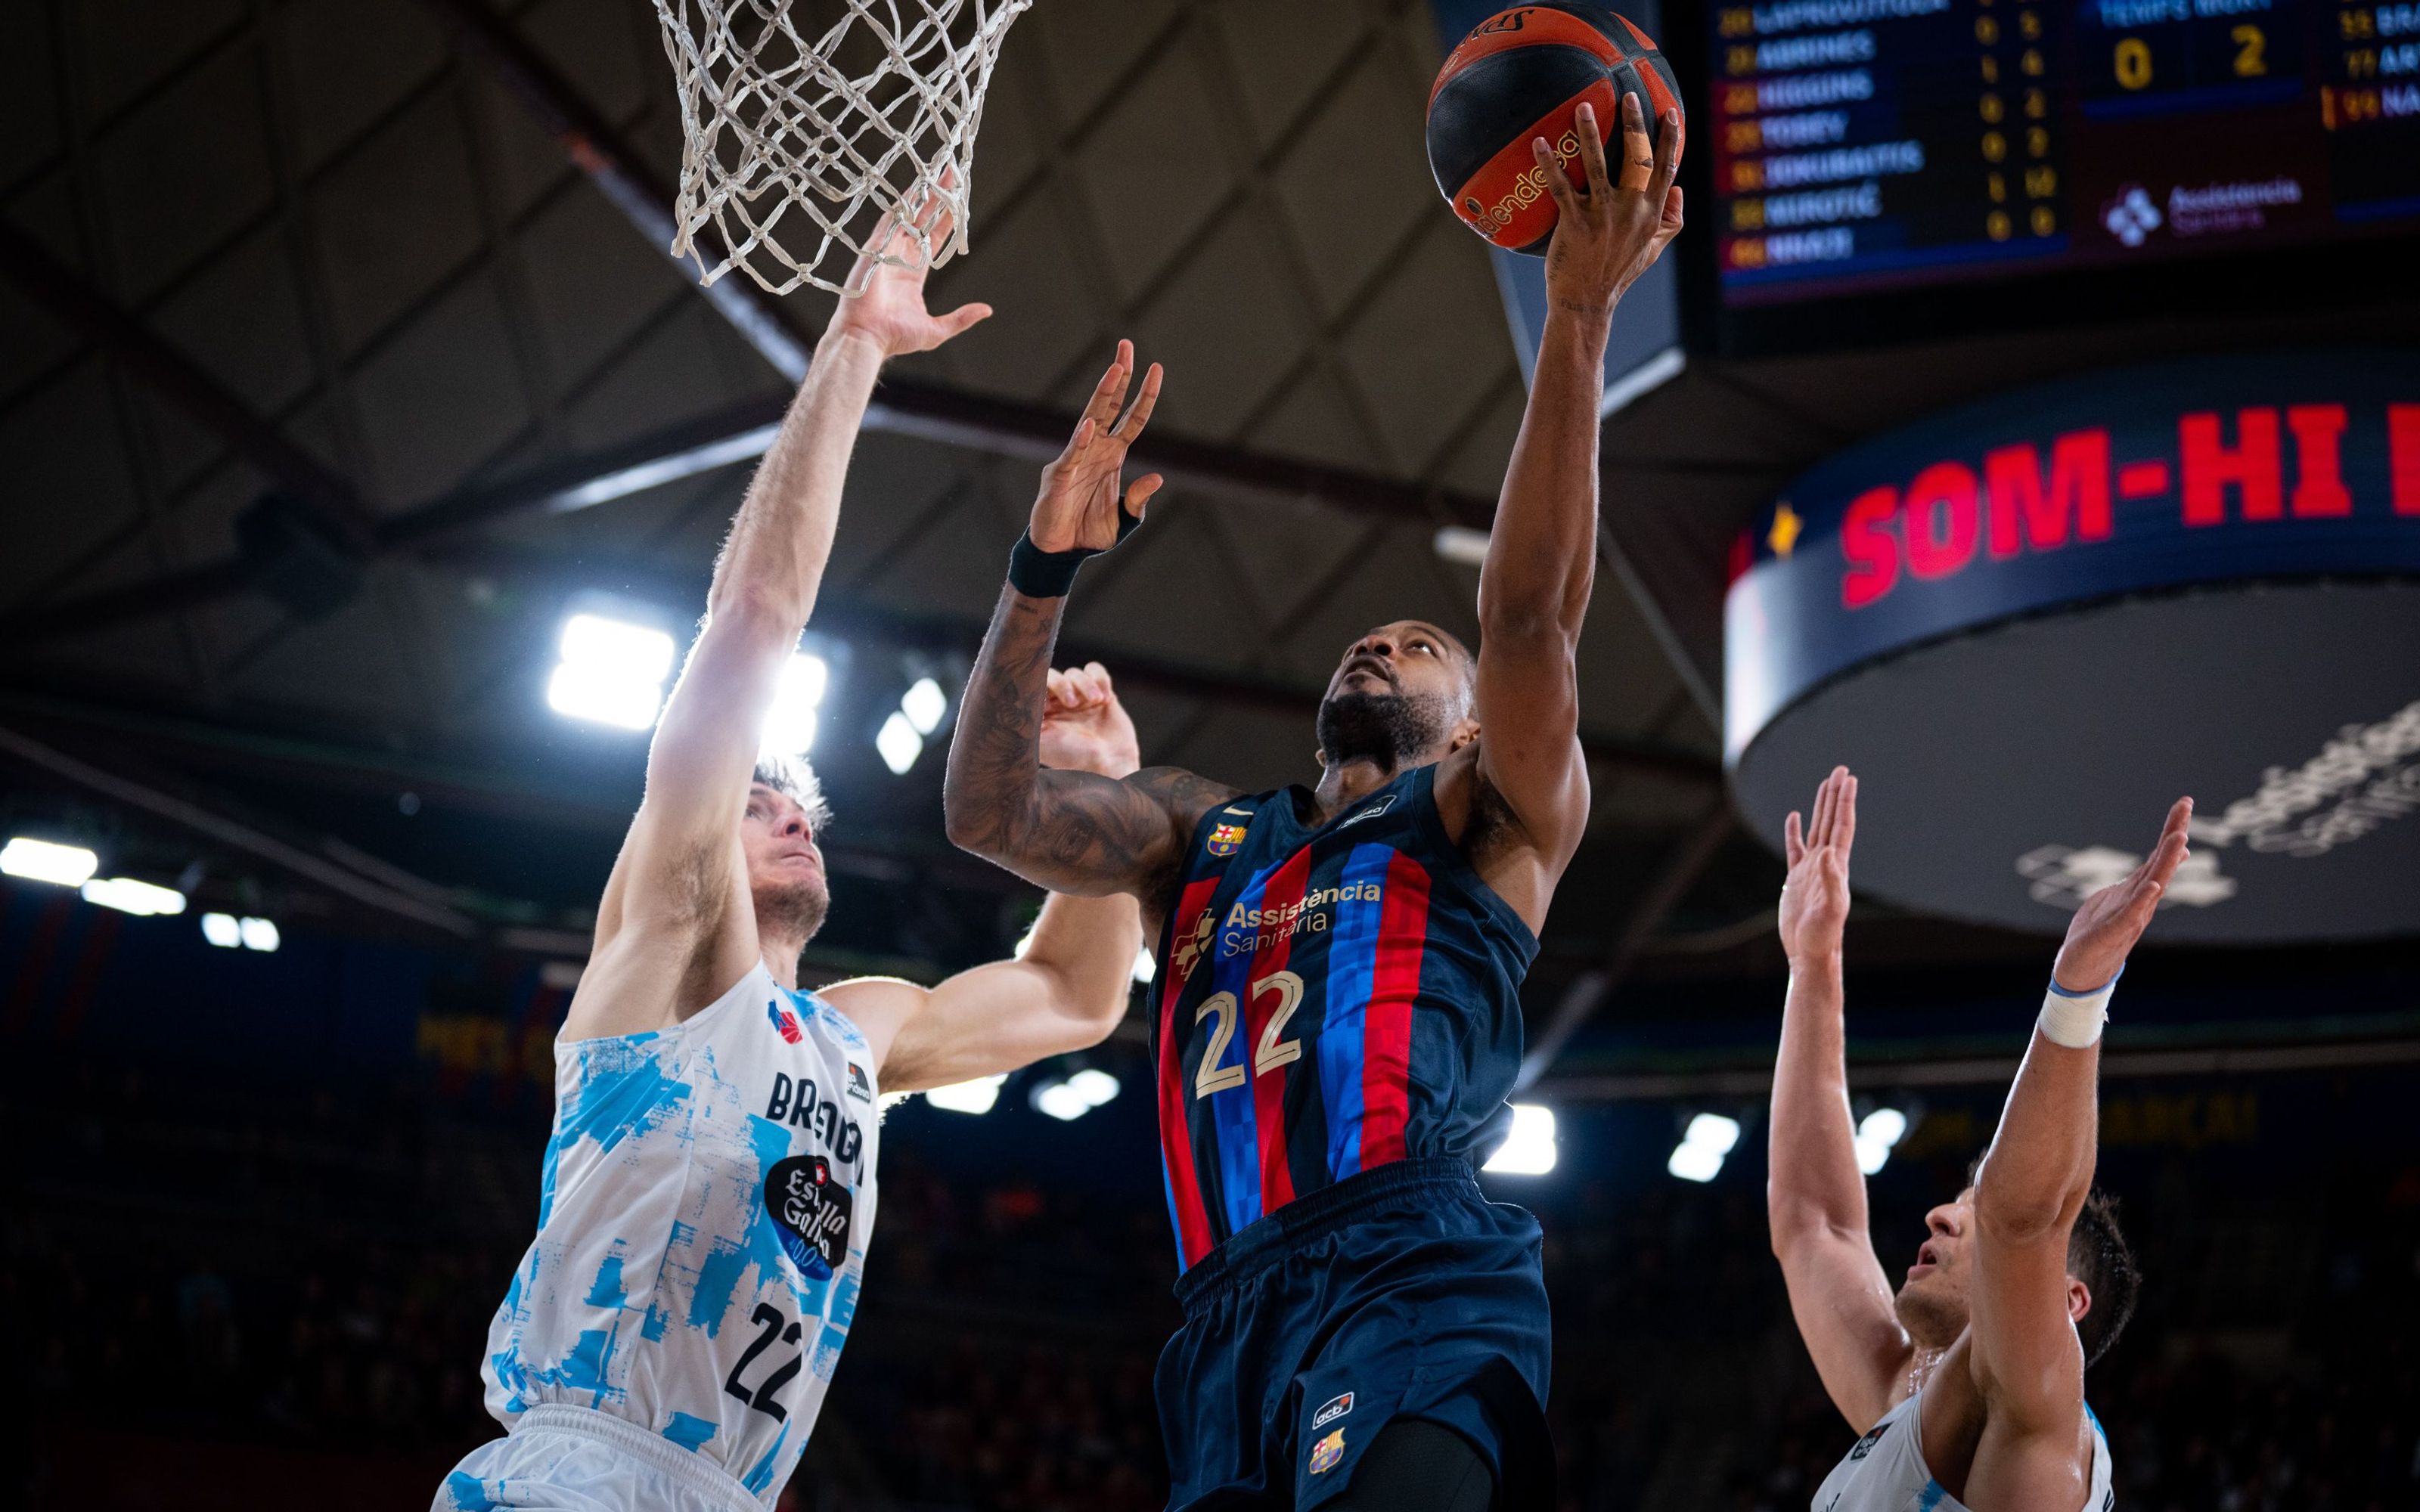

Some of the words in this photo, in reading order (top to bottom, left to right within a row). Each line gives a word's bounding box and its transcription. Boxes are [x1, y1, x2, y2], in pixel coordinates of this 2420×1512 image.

[2114, 38, 2153, 89] 0
[2231, 24, 2266, 76] 2
[1841, 404, 2353, 609] SOM-HI
[1226, 880, 1380, 928] Assistència
[1223, 910, 1326, 957] Sanitària
[1195, 970, 1305, 1101] 22
[724, 1302, 802, 1424] 22
[1316, 1405, 1342, 1424] acb
